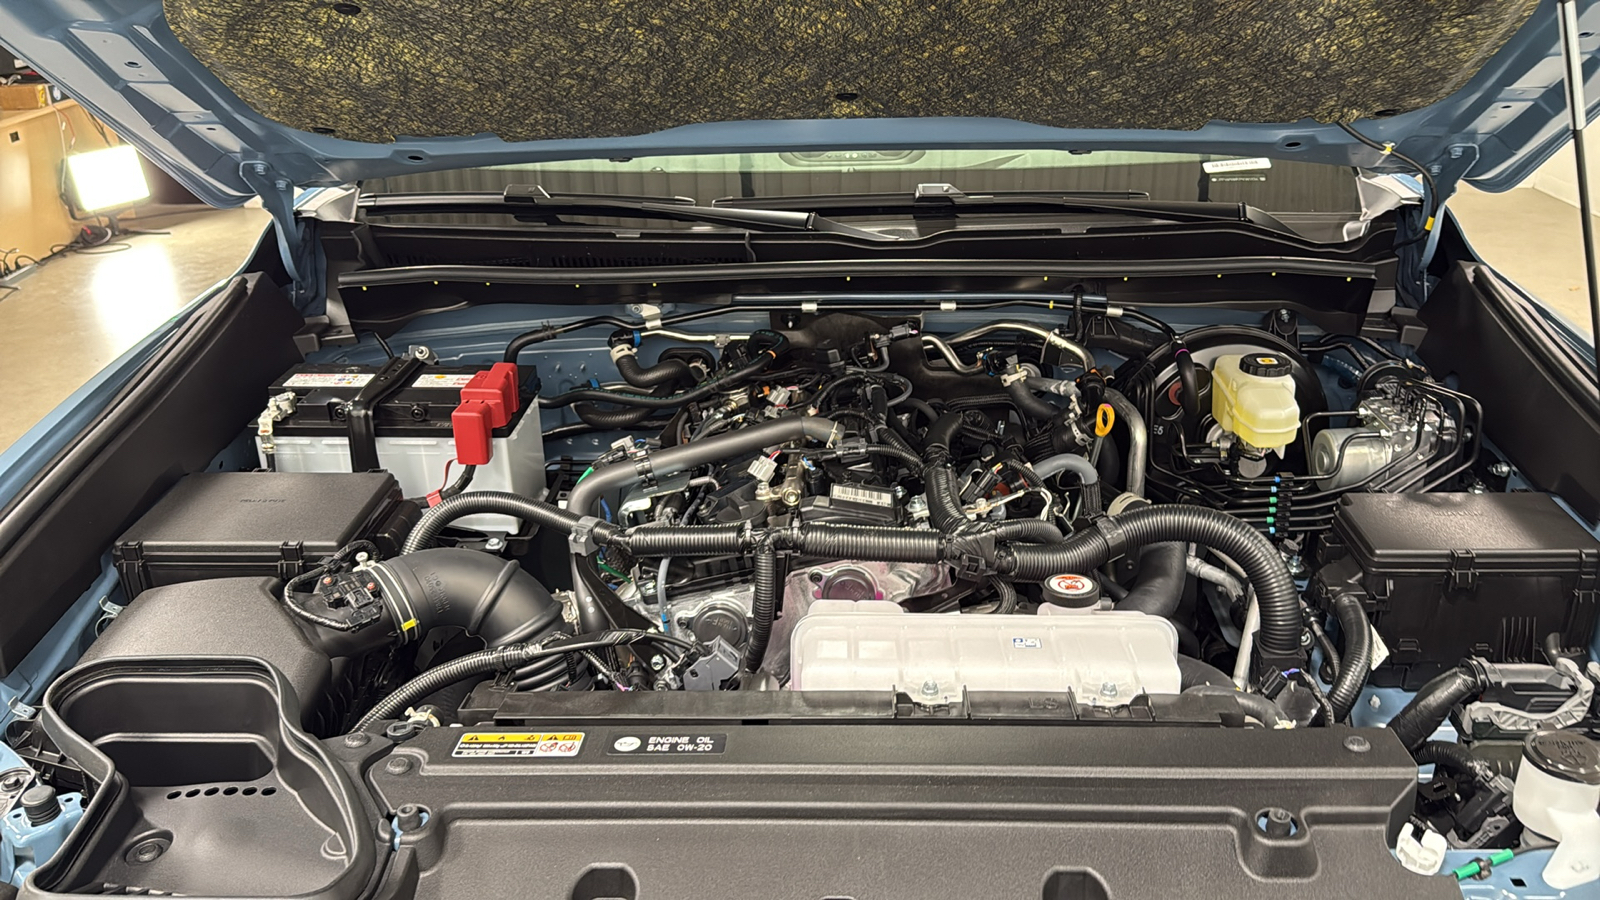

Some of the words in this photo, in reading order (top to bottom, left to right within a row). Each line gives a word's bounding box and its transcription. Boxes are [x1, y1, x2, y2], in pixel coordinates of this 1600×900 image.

[648, 736, 690, 744] ENGINE
[696, 736, 714, 744] OIL
[646, 744, 671, 752] SAE
[676, 744, 713, 752] 0W-20
